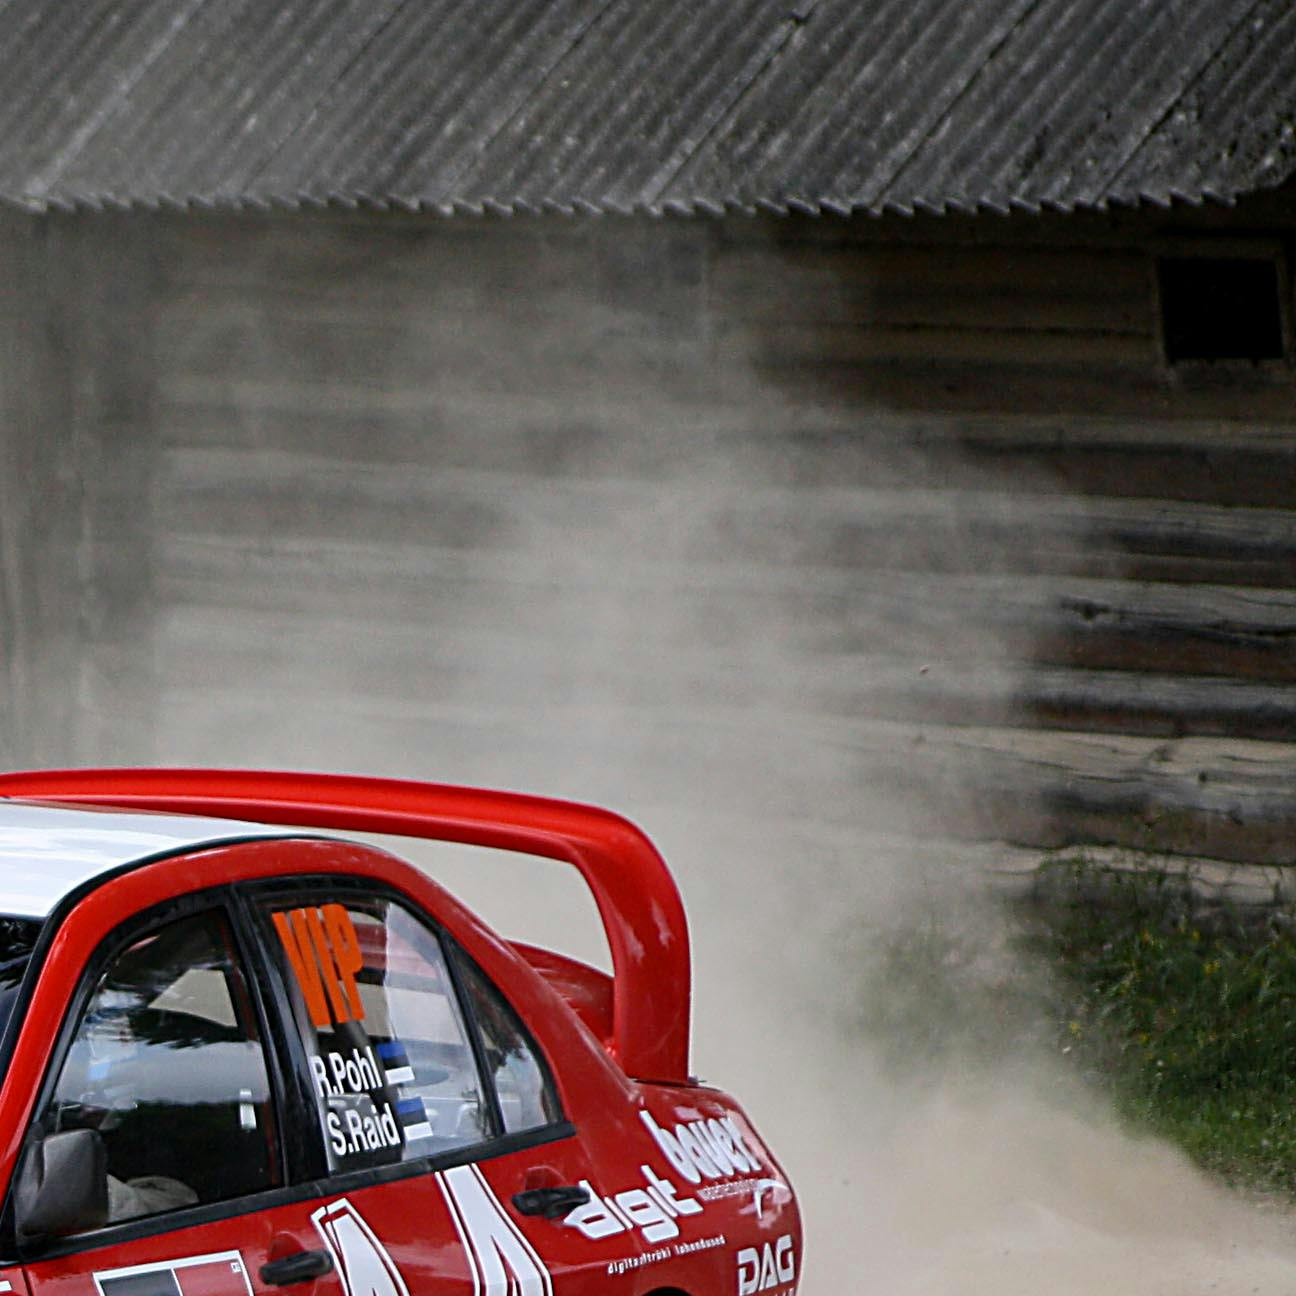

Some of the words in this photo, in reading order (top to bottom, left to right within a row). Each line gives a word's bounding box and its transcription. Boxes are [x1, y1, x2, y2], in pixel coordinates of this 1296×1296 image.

[272, 904, 365, 1028] VIP
[310, 1046, 383, 1098] R.Pohl
[328, 1103, 401, 1156] S.Raid
[563, 1165, 704, 1244] digit
[737, 1234, 795, 1296] DAG
